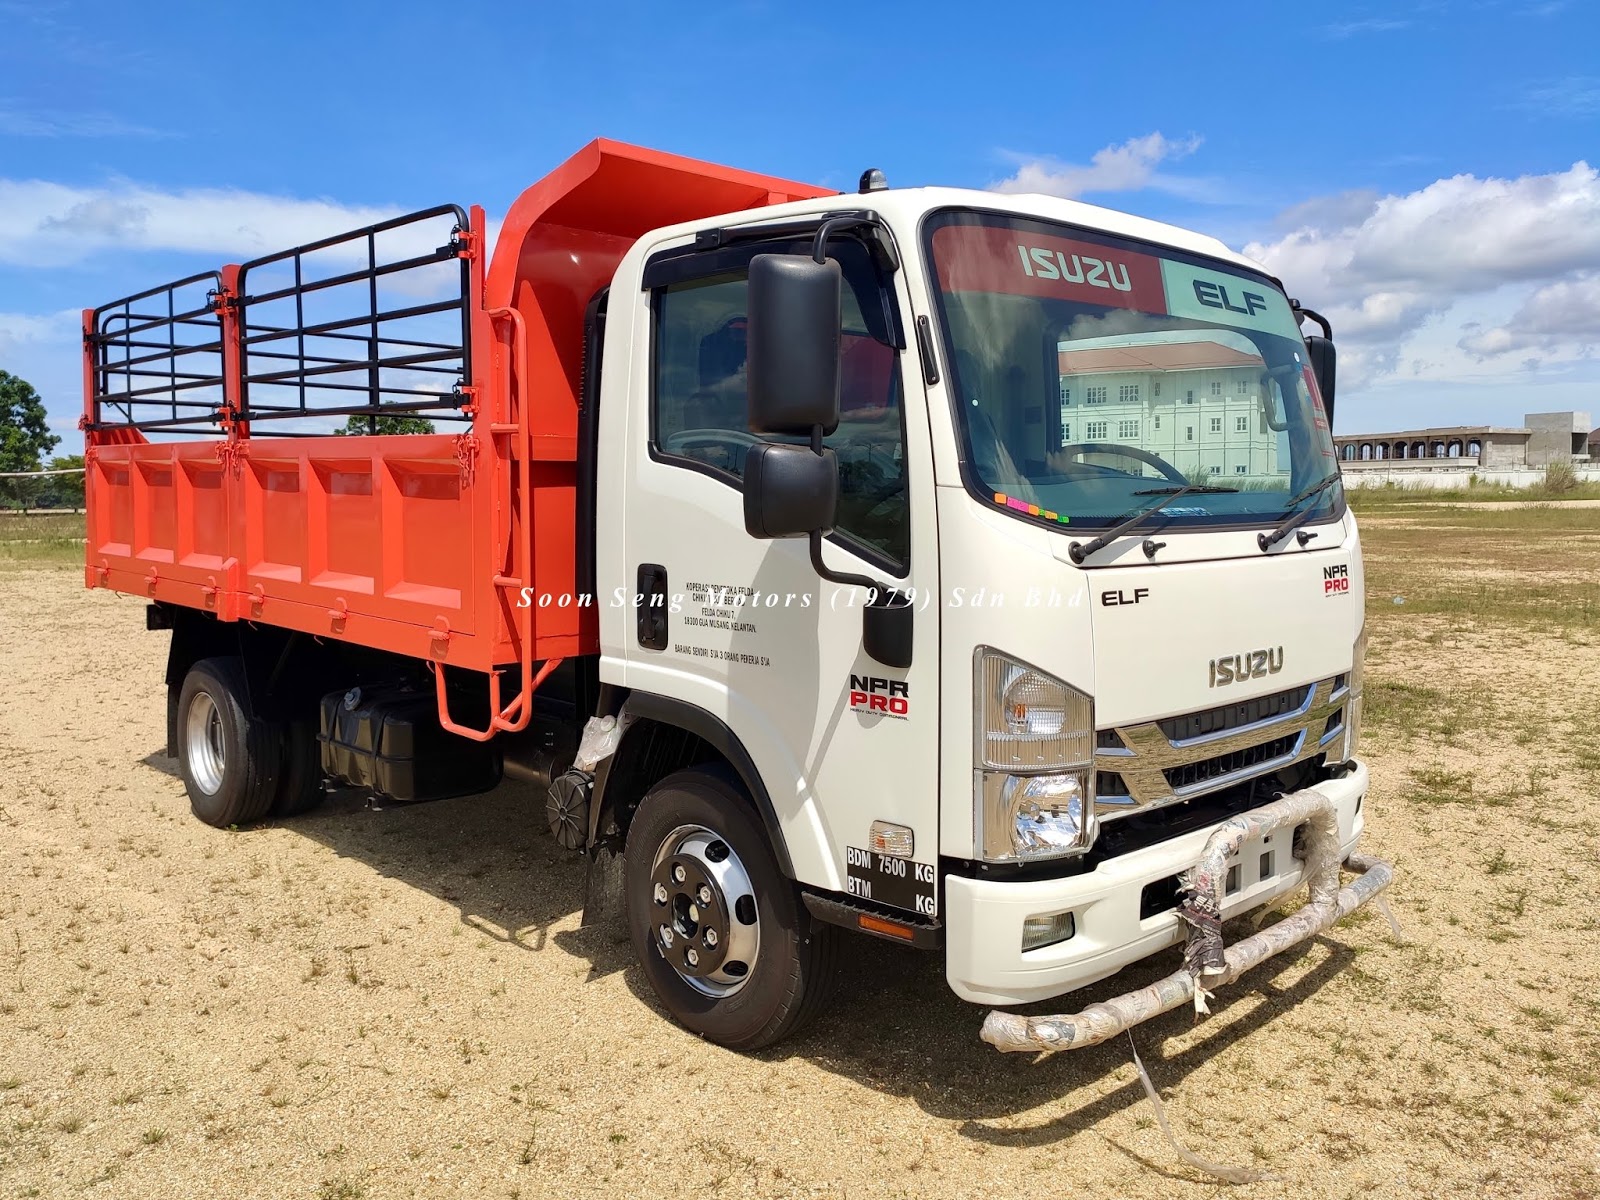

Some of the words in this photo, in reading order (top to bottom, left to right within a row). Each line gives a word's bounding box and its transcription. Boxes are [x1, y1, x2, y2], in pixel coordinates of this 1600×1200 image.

[1017, 245, 1132, 292] ISUZU
[1192, 278, 1267, 316] ELF
[1323, 564, 1348, 579] NPR
[1325, 578, 1349, 593] PRO
[1101, 588, 1149, 607] ELF
[684, 616, 699, 626] 18300
[699, 618, 709, 627] GUA
[701, 607, 716, 617] FELDA
[716, 609, 731, 619] CHIKU
[674, 644, 692, 655] BARANG
[719, 651, 724, 660] 3
[724, 651, 739, 662] ORANG
[1208, 645, 1284, 688] ISUZU
[850, 674, 909, 698] NPR
[850, 691, 908, 714] PRO
[847, 847, 872, 869] BDM
[878, 854, 907, 878] 7500
[914, 863, 934, 884] KG
[847, 875, 872, 899] BTM
[915, 894, 935, 915] KG
